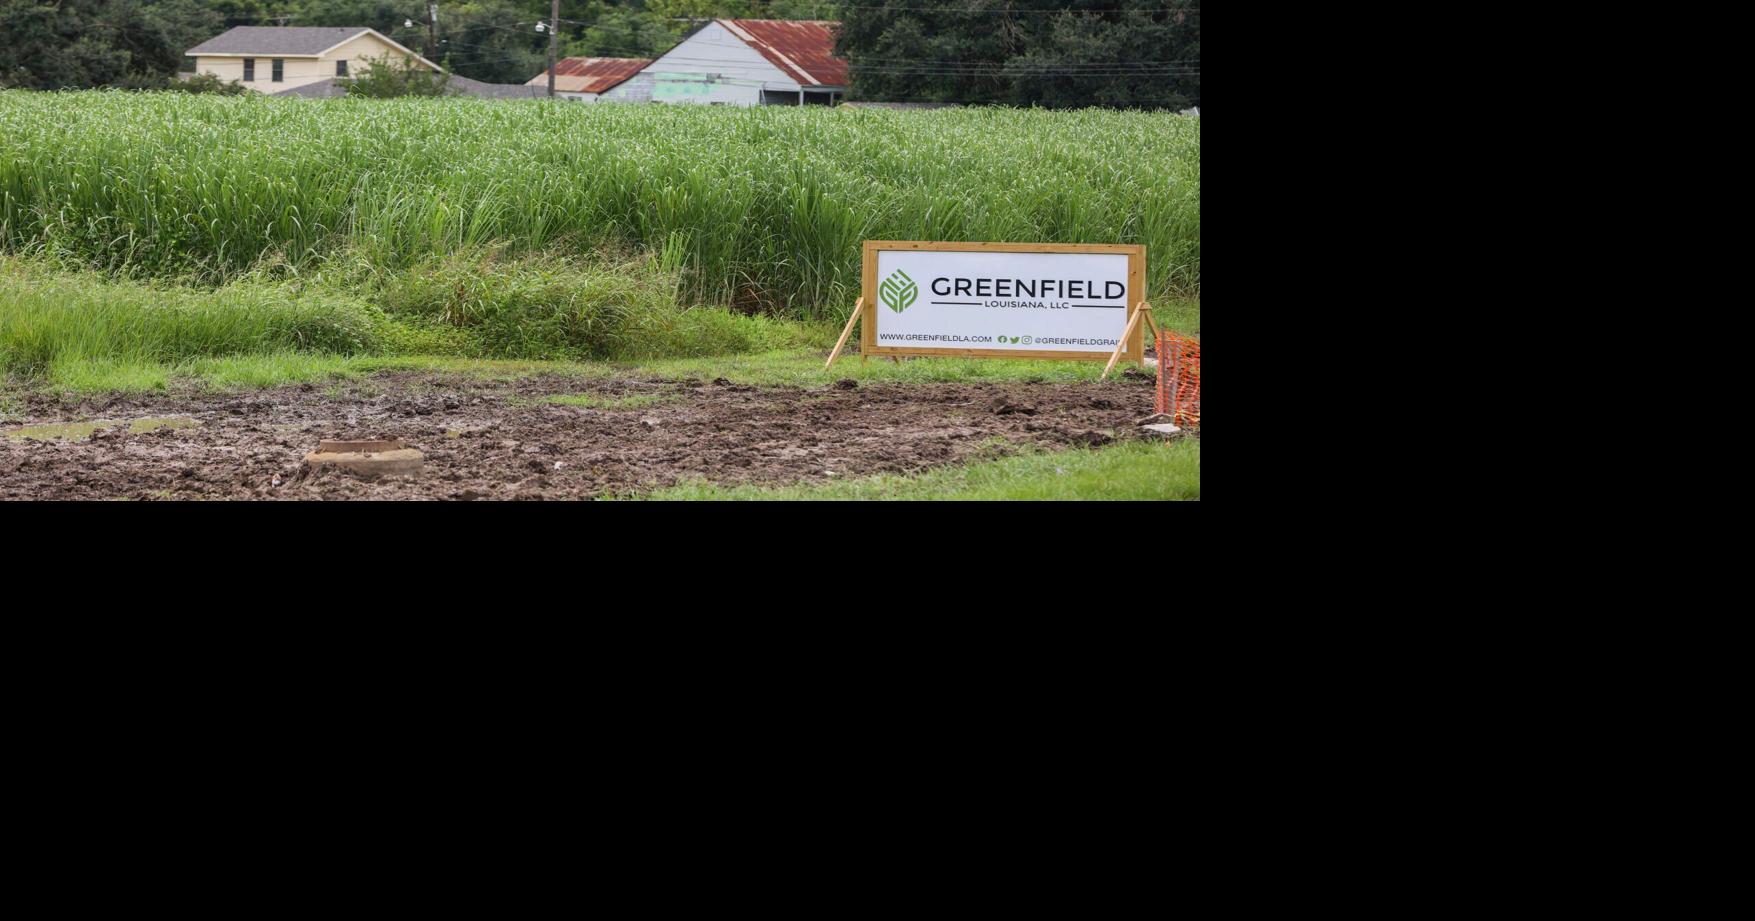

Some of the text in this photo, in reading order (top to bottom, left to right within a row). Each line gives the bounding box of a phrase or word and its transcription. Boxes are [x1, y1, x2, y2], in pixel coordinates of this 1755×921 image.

[931, 277, 1125, 299] GREENFIELD
[984, 299, 1070, 309] LOUISIANA, LLC
[879, 333, 993, 343] WWW.GREENFIELDLA.COM
[1034, 337, 1120, 346] @GREENFIELDGRAI
